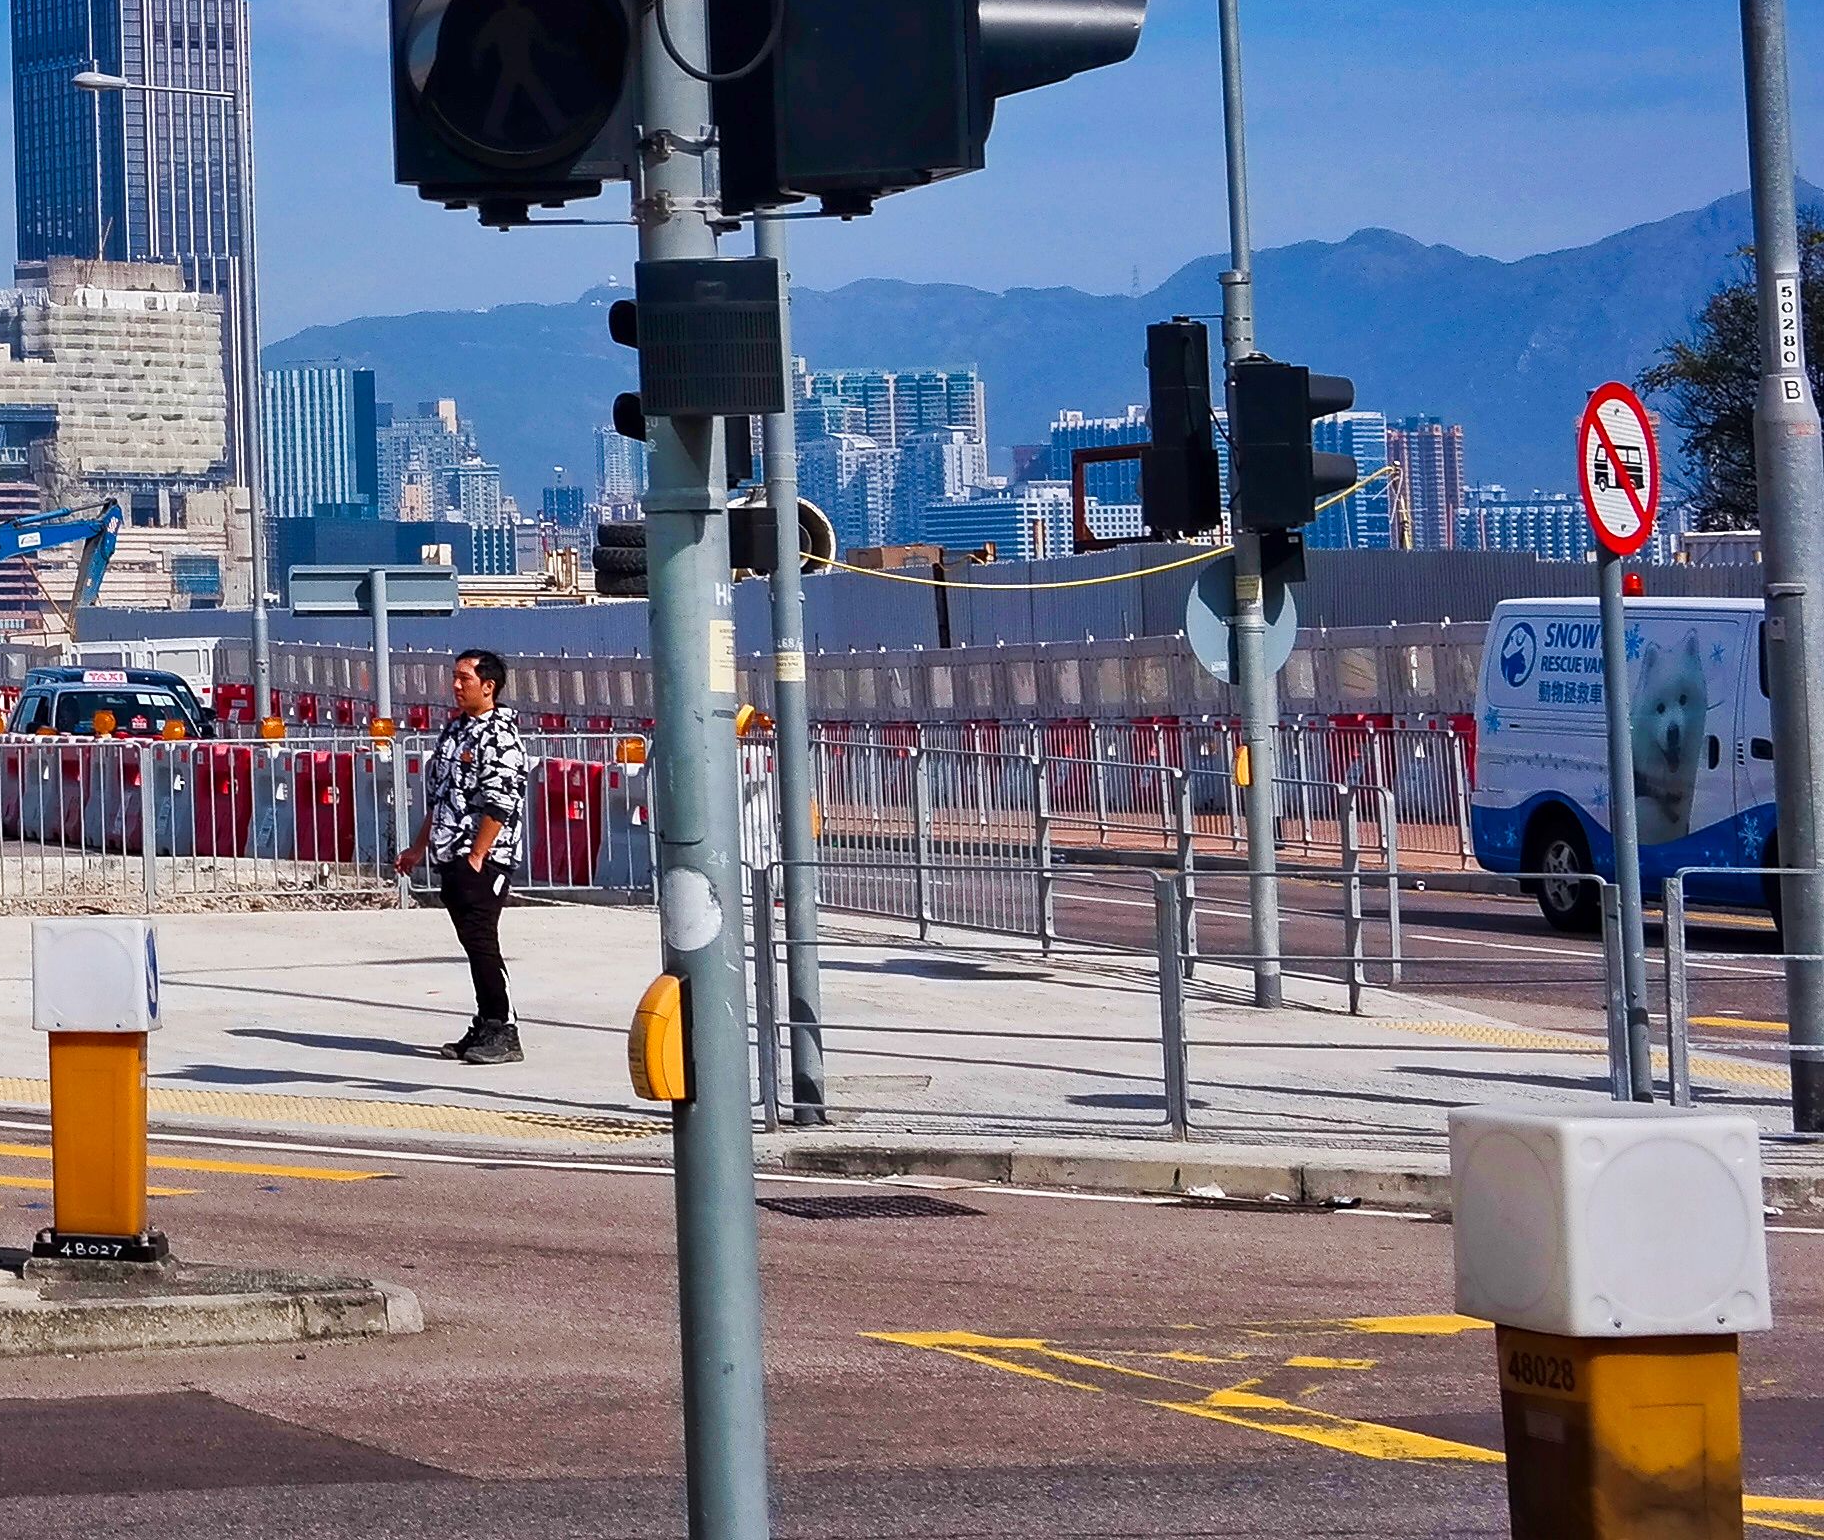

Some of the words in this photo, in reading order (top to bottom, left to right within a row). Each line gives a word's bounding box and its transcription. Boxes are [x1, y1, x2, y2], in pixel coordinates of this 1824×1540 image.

[1781, 286, 1796, 363] 50280
[1784, 380, 1801, 400] B
[1544, 622, 1601, 648] SNOW
[1540, 655, 1580, 674] RESCUE
[88, 672, 124, 682] TAXI
[1538, 680, 1603, 705] 動物拯救車
[60, 1241, 123, 1257] 48027
[1507, 1350, 1576, 1392] 48028
